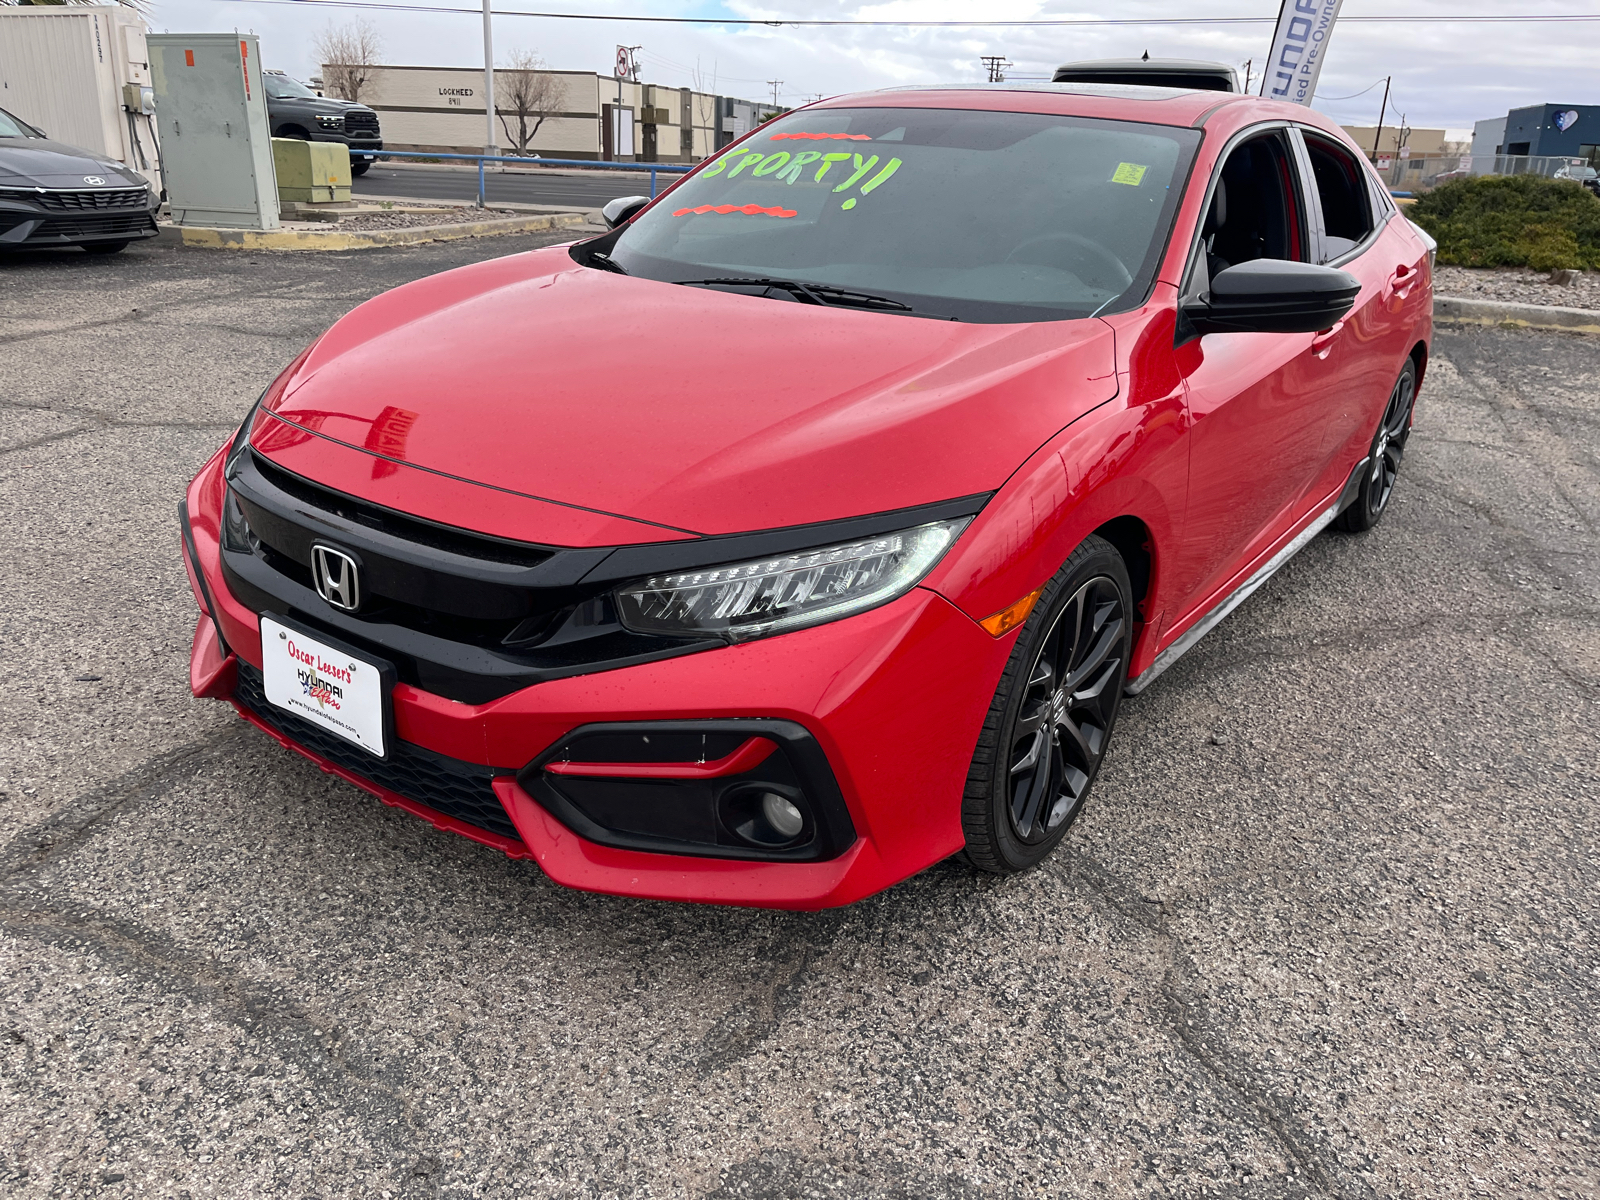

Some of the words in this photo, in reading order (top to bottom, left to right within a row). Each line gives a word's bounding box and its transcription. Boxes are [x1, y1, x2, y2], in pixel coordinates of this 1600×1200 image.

[1271, 0, 1317, 98] UNDA
[1300, 0, 1336, 75] Pre-Owne
[438, 87, 474, 96] LOCKHEED
[287, 640, 315, 671] Oscar
[317, 655, 352, 684] Leeser's
[297, 668, 343, 699] HYUNDAI
[311, 686, 323, 699] El
[320, 690, 341, 710] Paso
